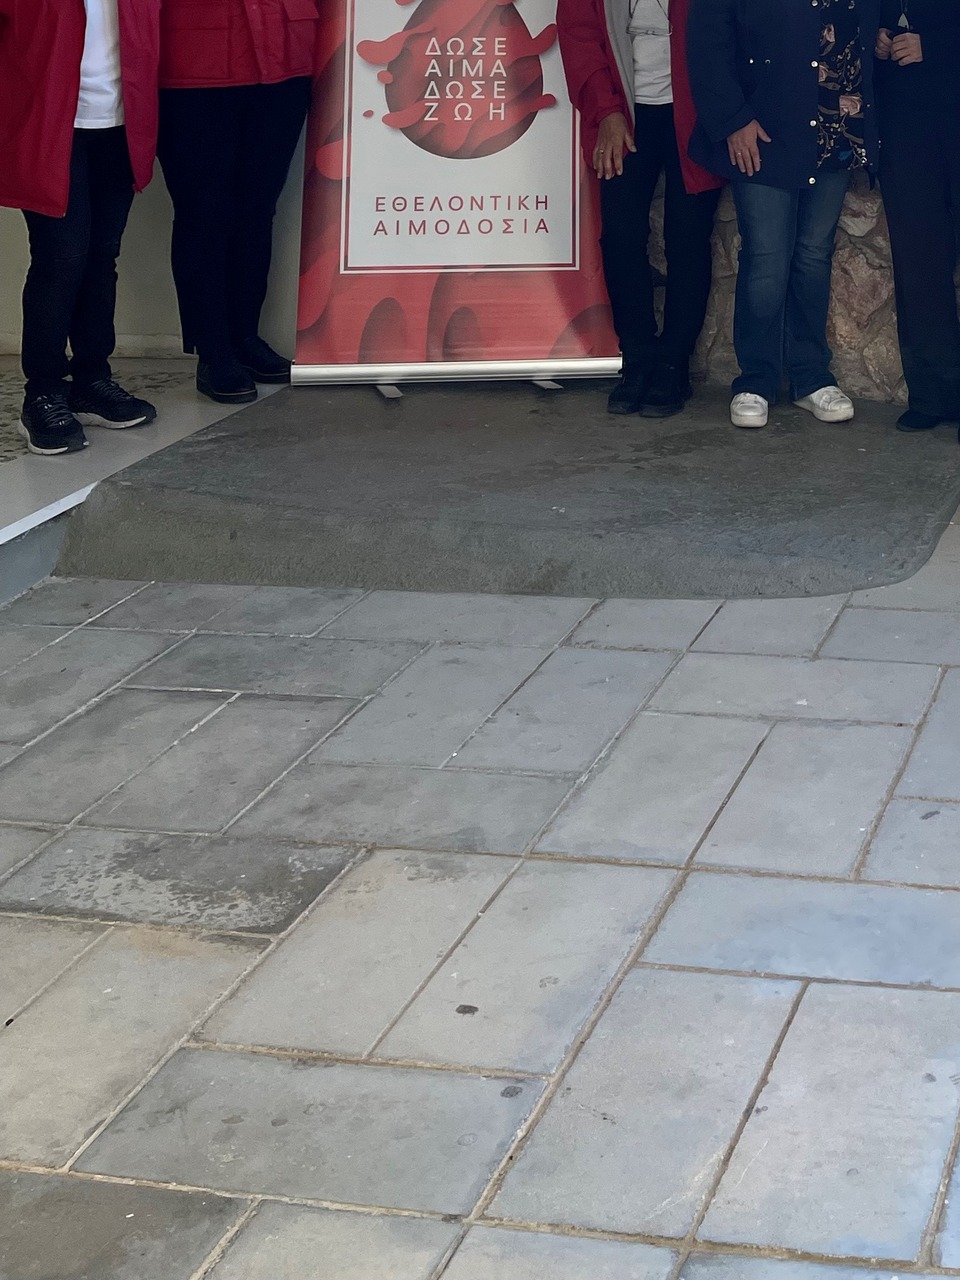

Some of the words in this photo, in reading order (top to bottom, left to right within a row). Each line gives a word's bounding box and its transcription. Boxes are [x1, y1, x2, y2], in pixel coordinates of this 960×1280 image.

[425, 37, 507, 56] ΔΩΣΕ
[424, 59, 507, 78] ΑΙΜΑ
[424, 80, 506, 99] ΔΩΣΕ
[423, 102, 506, 121] ΖΩΗ
[375, 195, 549, 212] ΕΘΕΛΟΝΤΙΚΗ
[373, 218, 549, 236] ΑΙΜΟΔΟΣΙΑ
